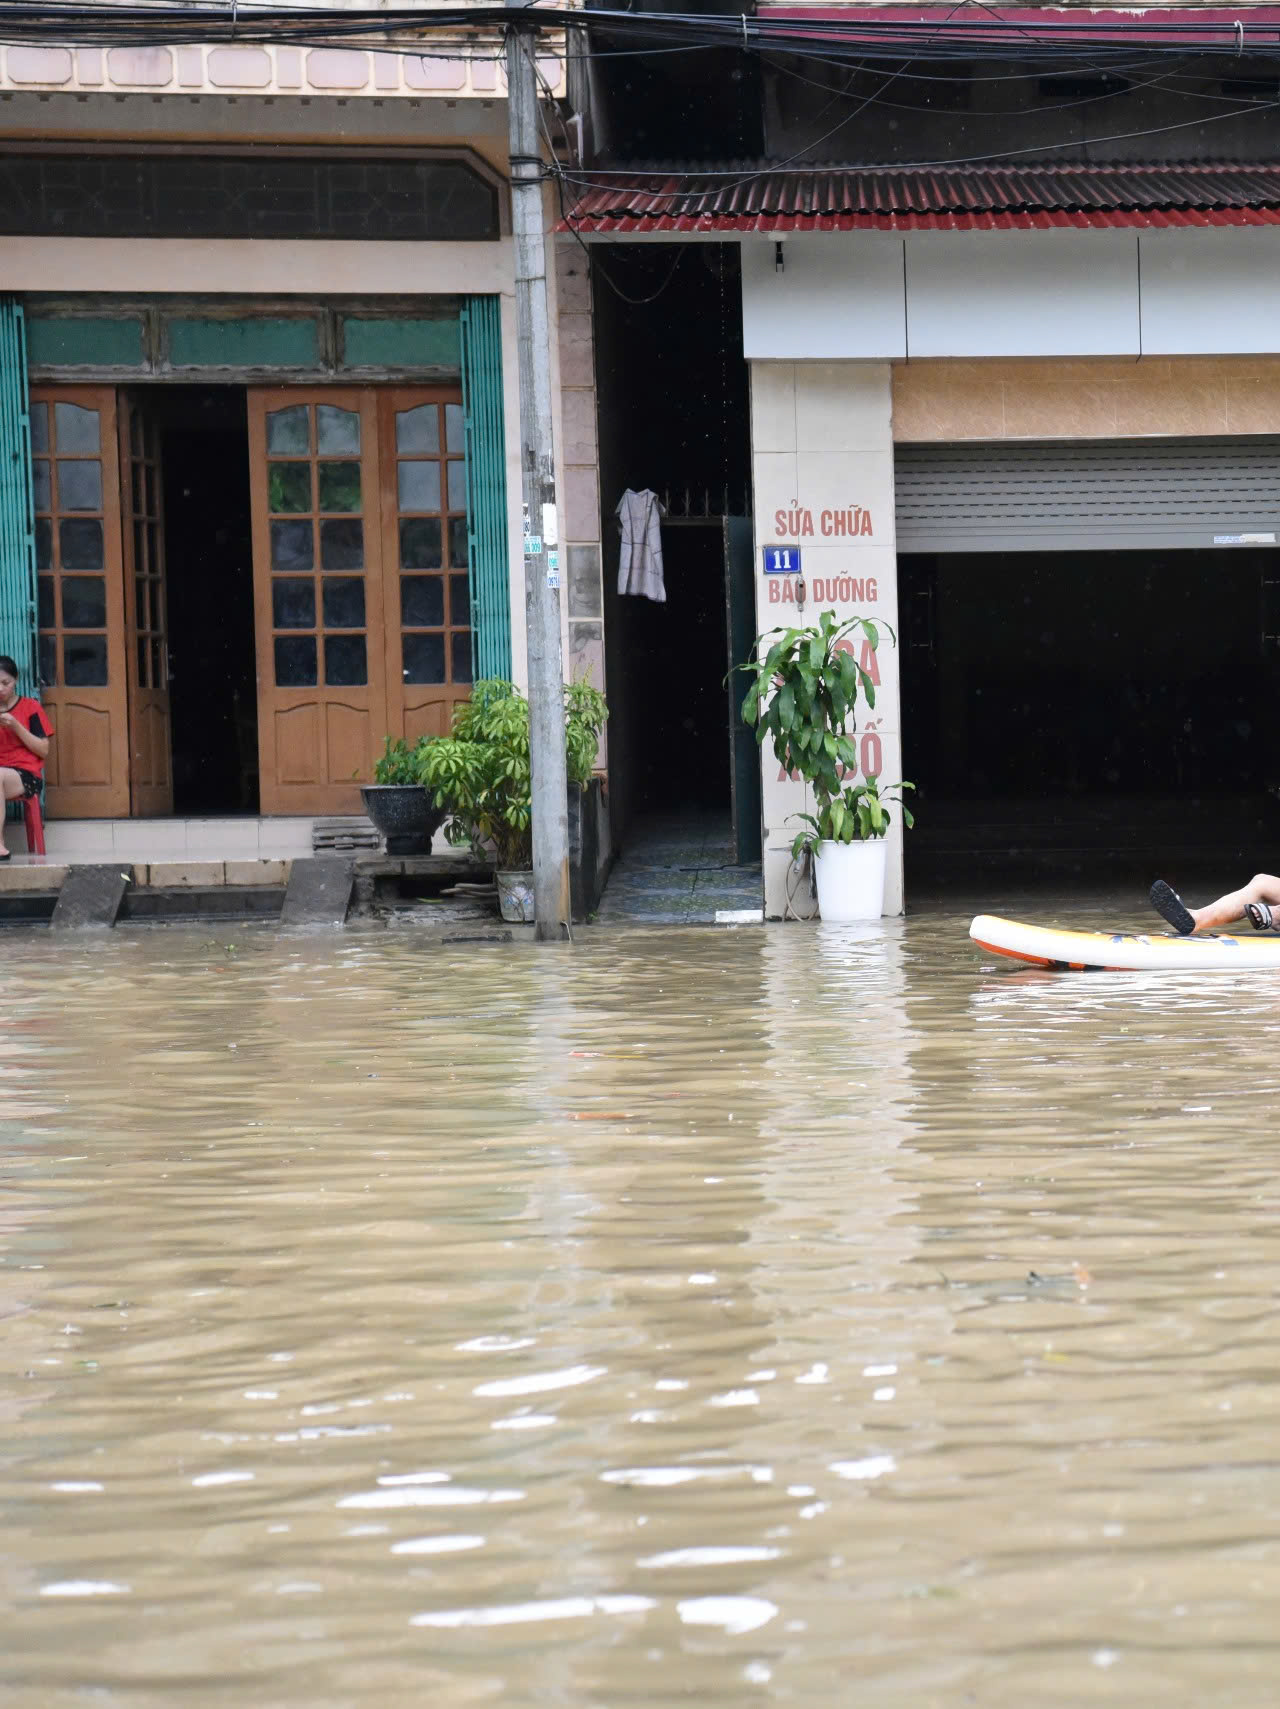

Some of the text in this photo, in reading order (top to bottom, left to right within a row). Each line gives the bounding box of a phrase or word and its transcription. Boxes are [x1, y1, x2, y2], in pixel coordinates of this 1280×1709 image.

[775, 499, 874, 537] SỬA CHỮA
[773, 550, 792, 569] 11
[812, 570, 878, 603] DƯỠNG
